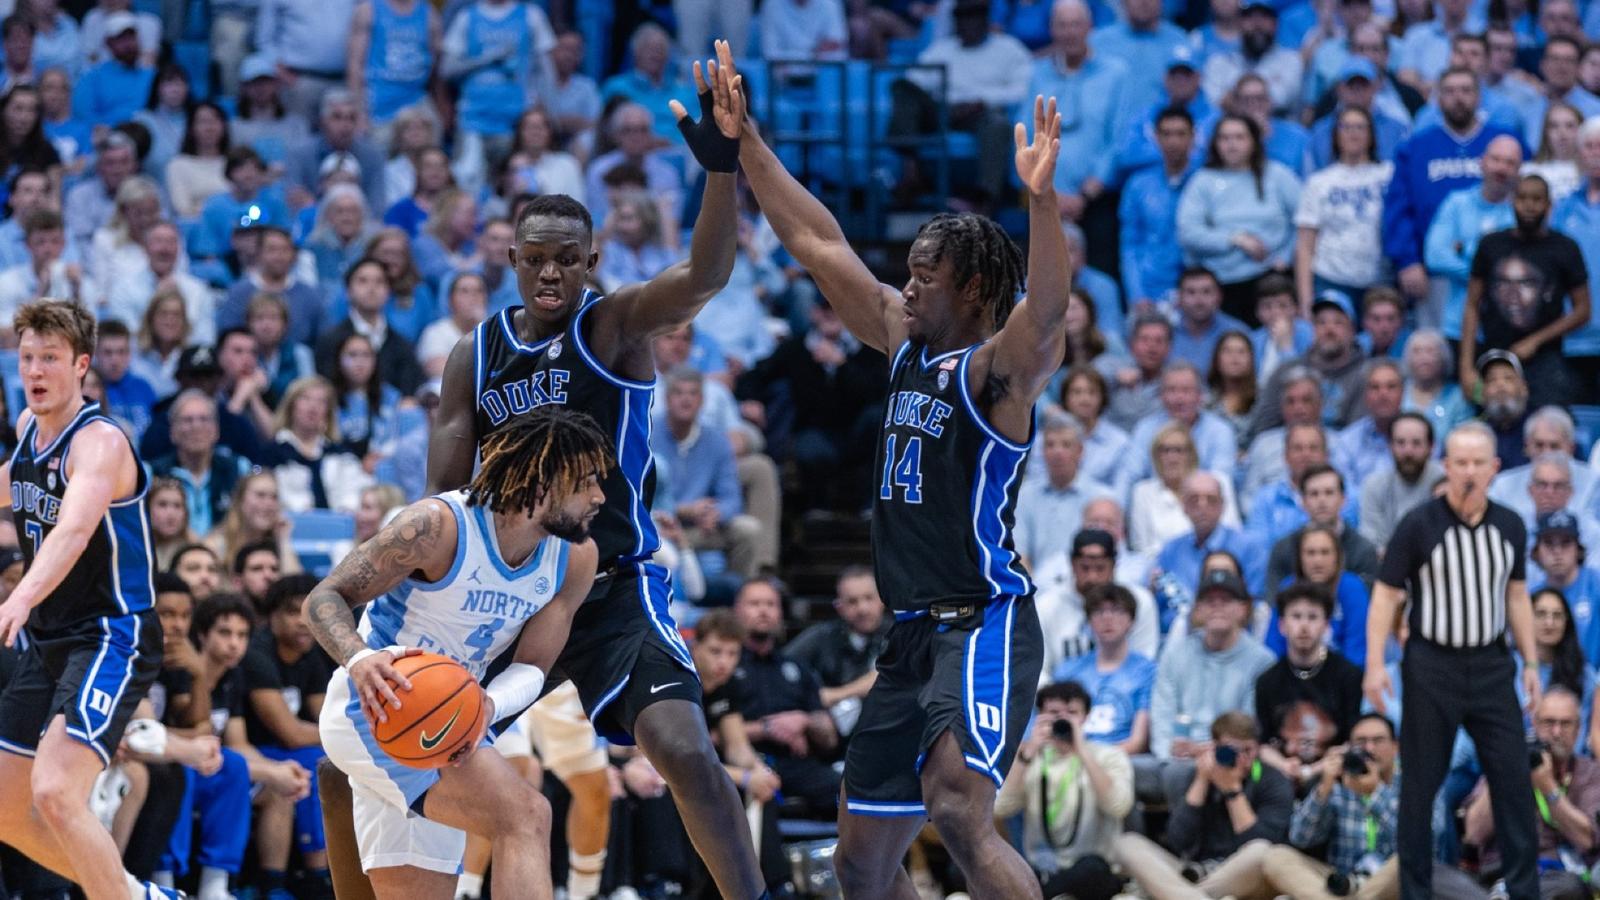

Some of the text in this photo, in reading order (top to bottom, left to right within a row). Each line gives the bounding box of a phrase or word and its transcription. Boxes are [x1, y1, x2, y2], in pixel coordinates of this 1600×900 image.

[481, 369, 570, 426] DUKE
[880, 433, 922, 504] 14
[12, 481, 63, 525] DUKE
[25, 519, 43, 559] 7
[460, 590, 539, 620] NORTH
[464, 618, 506, 661] 4
[89, 687, 112, 716] D
[976, 701, 1000, 732] D
